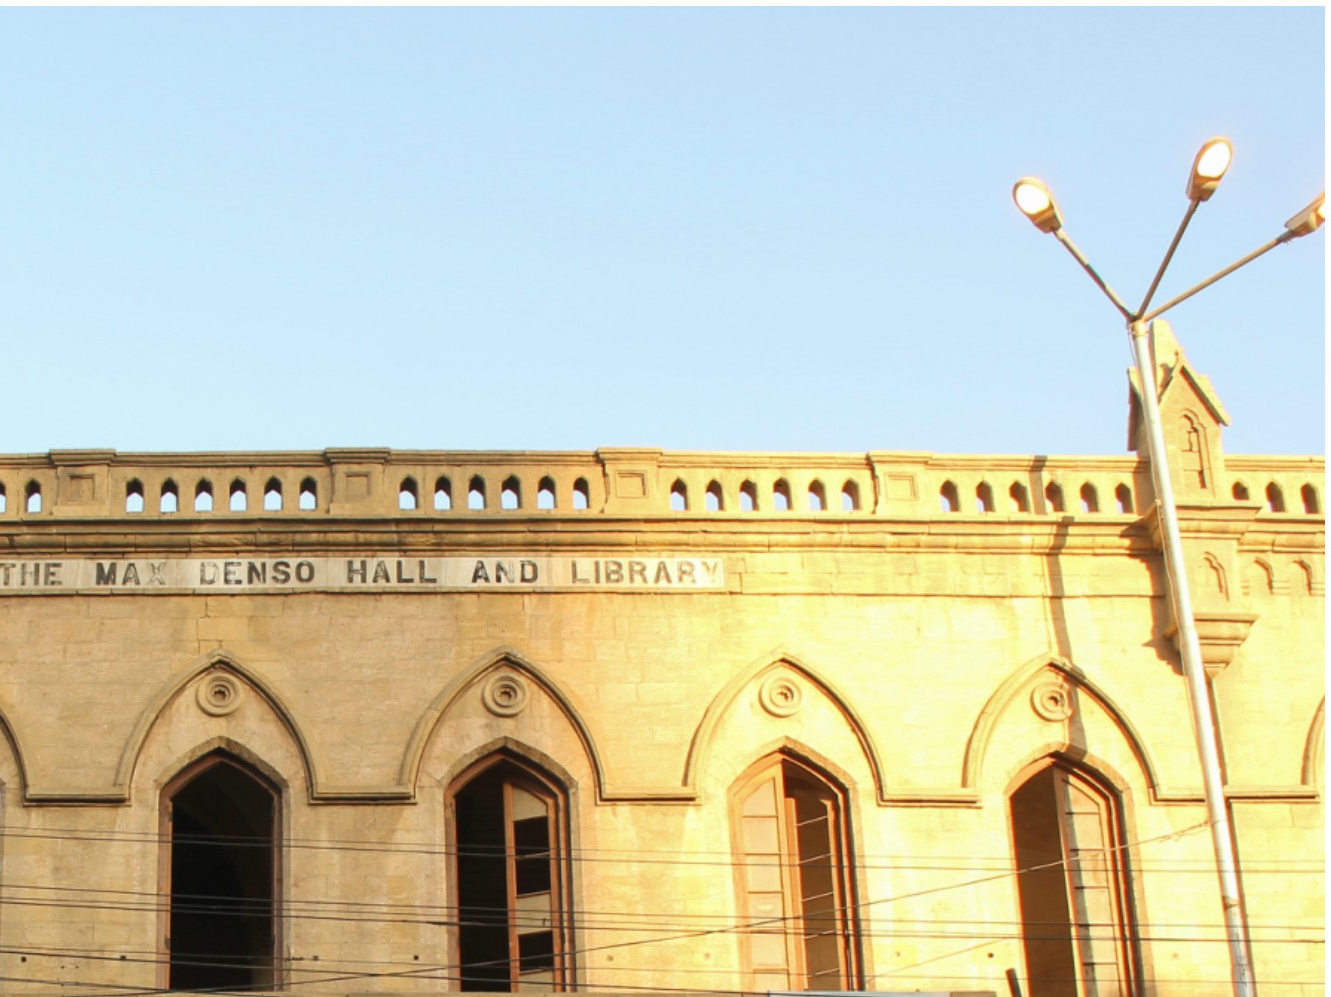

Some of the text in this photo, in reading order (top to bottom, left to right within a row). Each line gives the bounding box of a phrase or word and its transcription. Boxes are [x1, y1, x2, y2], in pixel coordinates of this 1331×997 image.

[95, 561, 168, 586] MAX
[199, 560, 316, 586] DENSO
[346, 560, 438, 584] HALL
[470, 560, 539, 584] AND
[571, 559, 722, 585] LIBRARY
